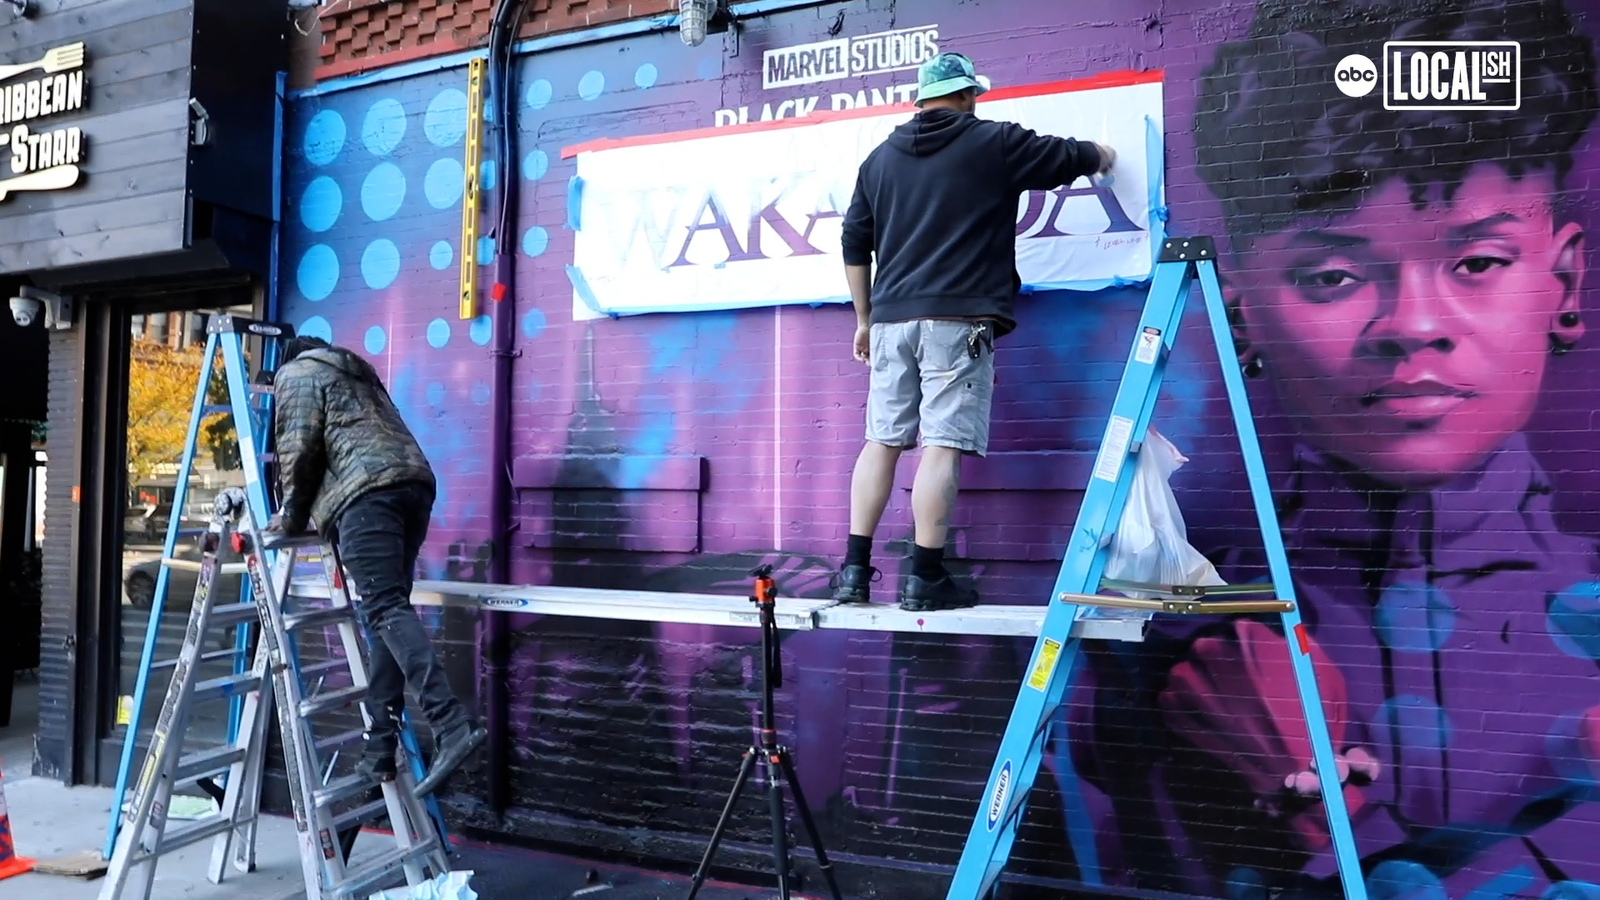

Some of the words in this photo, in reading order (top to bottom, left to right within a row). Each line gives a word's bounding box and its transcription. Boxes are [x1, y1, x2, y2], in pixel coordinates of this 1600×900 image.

[767, 45, 845, 84] MARVEL
[851, 29, 939, 72] STUDIOS
[590, 172, 1147, 271] WAKAA
[990, 773, 1008, 817] WERNER
